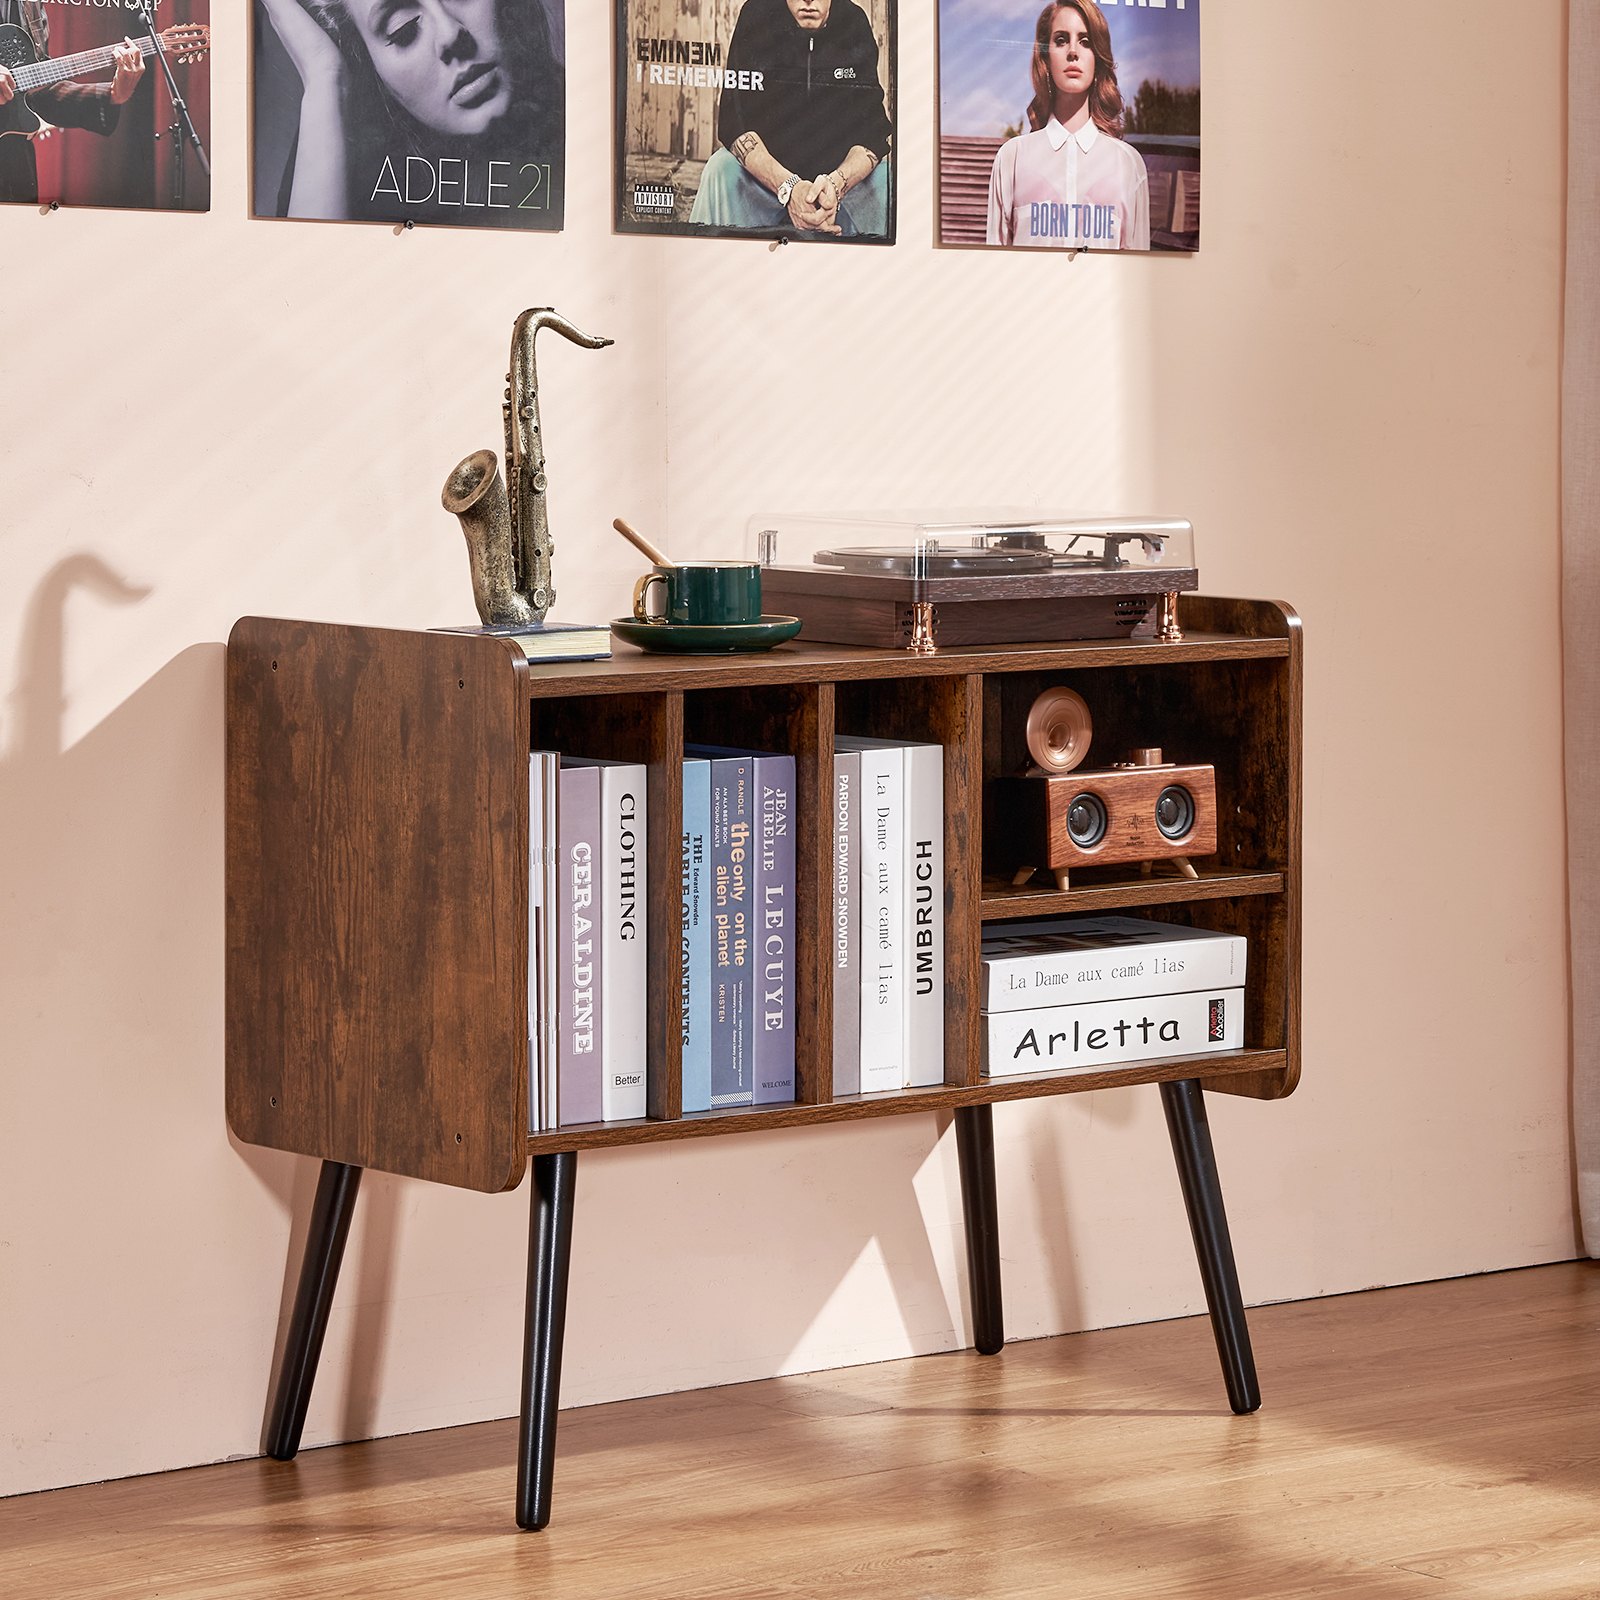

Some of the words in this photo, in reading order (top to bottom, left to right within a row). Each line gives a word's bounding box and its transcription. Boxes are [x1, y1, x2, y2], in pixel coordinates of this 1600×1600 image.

[637, 38, 721, 66] EMINEM
[636, 63, 643, 83] I
[649, 64, 765, 91] REMEMBER
[370, 155, 511, 208] ADELE
[517, 163, 551, 210] 21
[636, 185, 672, 193] PARENTAL
[636, 193, 673, 206] ADVISORY
[636, 206, 654, 214] EXPLICIT
[1030, 202, 1068, 238] BORN
[1071, 204, 1091, 239] TO
[1093, 205, 1115, 239] DIE
[722, 787, 728, 796] AN
[737, 779, 745, 815] RANDLE
[838, 774, 848, 831] PARDON
[877, 774, 889, 796] La
[763, 785, 775, 871] AURELIE
[775, 788, 787, 837] JEAN
[877, 807, 890, 851] Dame
[693, 834, 703, 864] THE
[730, 821, 749, 863] the
[620, 793, 636, 942] CLOTHING
[730, 864, 746, 901] only
[838, 835, 848, 894] EDWARD
[878, 862, 889, 894] aux
[716, 865, 729, 906] alien
[735, 912, 745, 935] on
[838, 897, 848, 968] SNOWDEN
[879, 906, 892, 950] camé
[916, 840, 933, 996] UMBRUCH
[715, 914, 731, 967] planet
[735, 938, 748, 966] the
[765, 884, 784, 1031] LECUYE
[879, 963, 893, 1005] lias
[1010, 973, 1026, 990] La
[1035, 970, 1069, 987] Dame
[1077, 969, 1102, 983] aux
[1111, 962, 1144, 979] camé
[1153, 957, 1185, 974] lias
[718, 983, 726, 1023] KRISTEN
[1013, 1016, 1180, 1059] Arletta
[615, 1074, 641, 1087] Better
[761, 1080, 792, 1089] WELCOME
